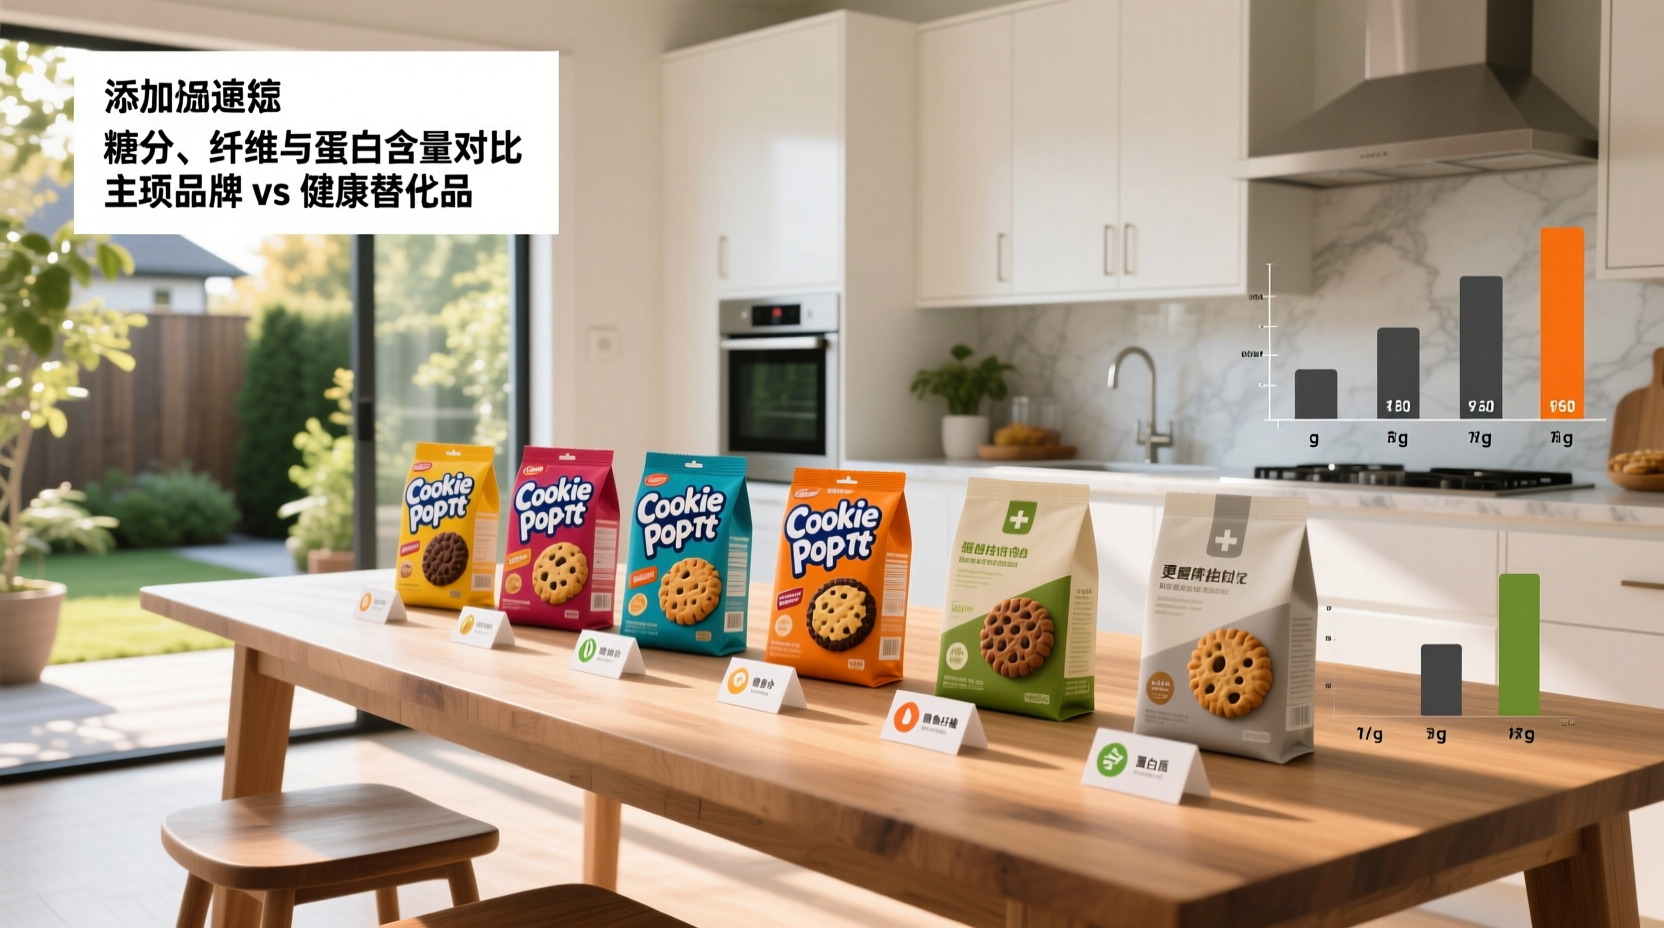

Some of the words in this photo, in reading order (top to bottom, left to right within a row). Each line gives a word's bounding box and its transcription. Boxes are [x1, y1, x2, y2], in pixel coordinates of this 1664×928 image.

[406, 472, 473, 505] Cookie
[515, 476, 592, 511] Cookie
[637, 486, 724, 524] Cookie
[786, 500, 879, 539] Cookie
